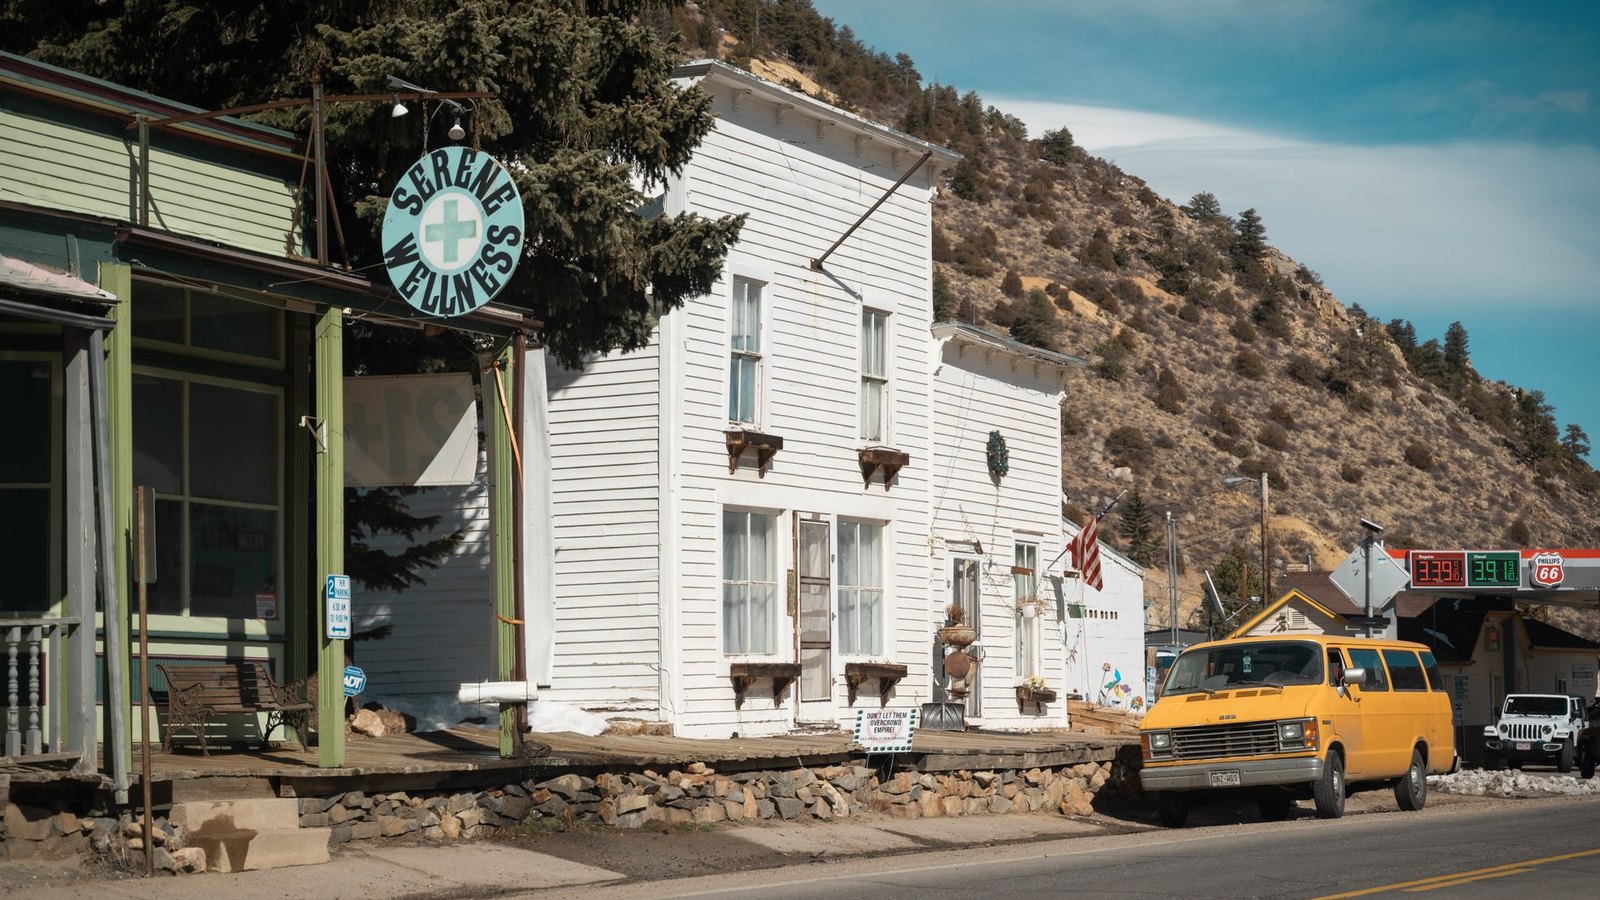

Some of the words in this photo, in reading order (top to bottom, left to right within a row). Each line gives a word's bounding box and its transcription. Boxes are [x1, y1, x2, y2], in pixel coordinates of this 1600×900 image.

[392, 148, 516, 217] SERENE
[384, 224, 521, 315] WELLNESS
[1537, 557, 1561, 565] PHILLIPS
[1540, 567, 1560, 580] 66
[328, 579, 334, 595] 2
[335, 588, 350, 597] PARKING
[344, 675, 364, 689] ADT
[873, 726, 895, 734] EMPIRE!
